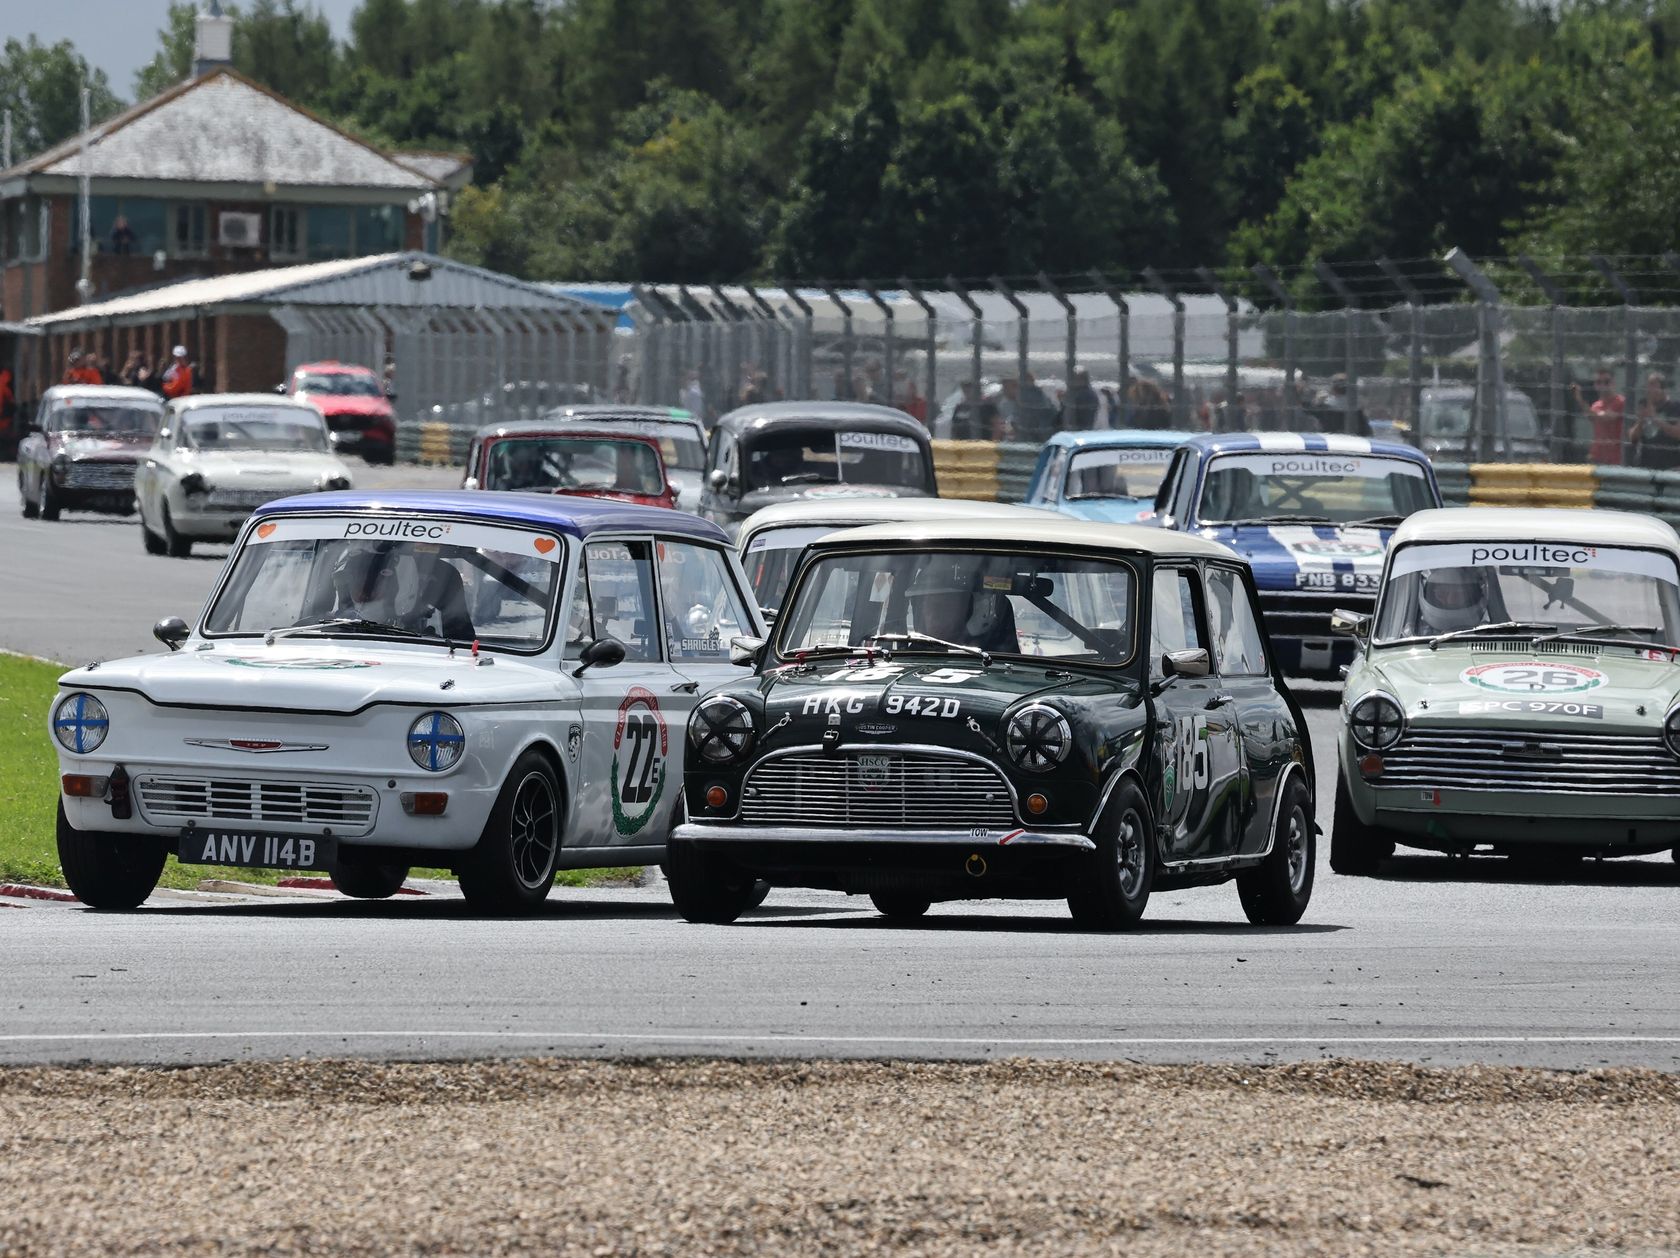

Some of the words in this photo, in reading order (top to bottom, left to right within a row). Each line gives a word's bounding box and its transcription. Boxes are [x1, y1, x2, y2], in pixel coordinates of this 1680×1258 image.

[840, 433, 911, 449] poultec
[1272, 460, 1355, 473] poultec
[344, 521, 444, 538] poultec
[1472, 545, 1589, 565] poultec
[1295, 572, 1336, 587] FNB
[682, 638, 722, 651] SHRIGLEY
[1503, 670, 1579, 686] 26
[802, 695, 866, 715] HKG
[886, 695, 960, 718] 942D
[1529, 702, 1598, 715] 970F
[621, 715, 657, 804] 22
[859, 757, 888, 767] HSCC
[1174, 715, 1208, 794] 185
[970, 828, 989, 837] TOW
[201, 834, 256, 863] ANV
[263, 837, 316, 867] 114B
